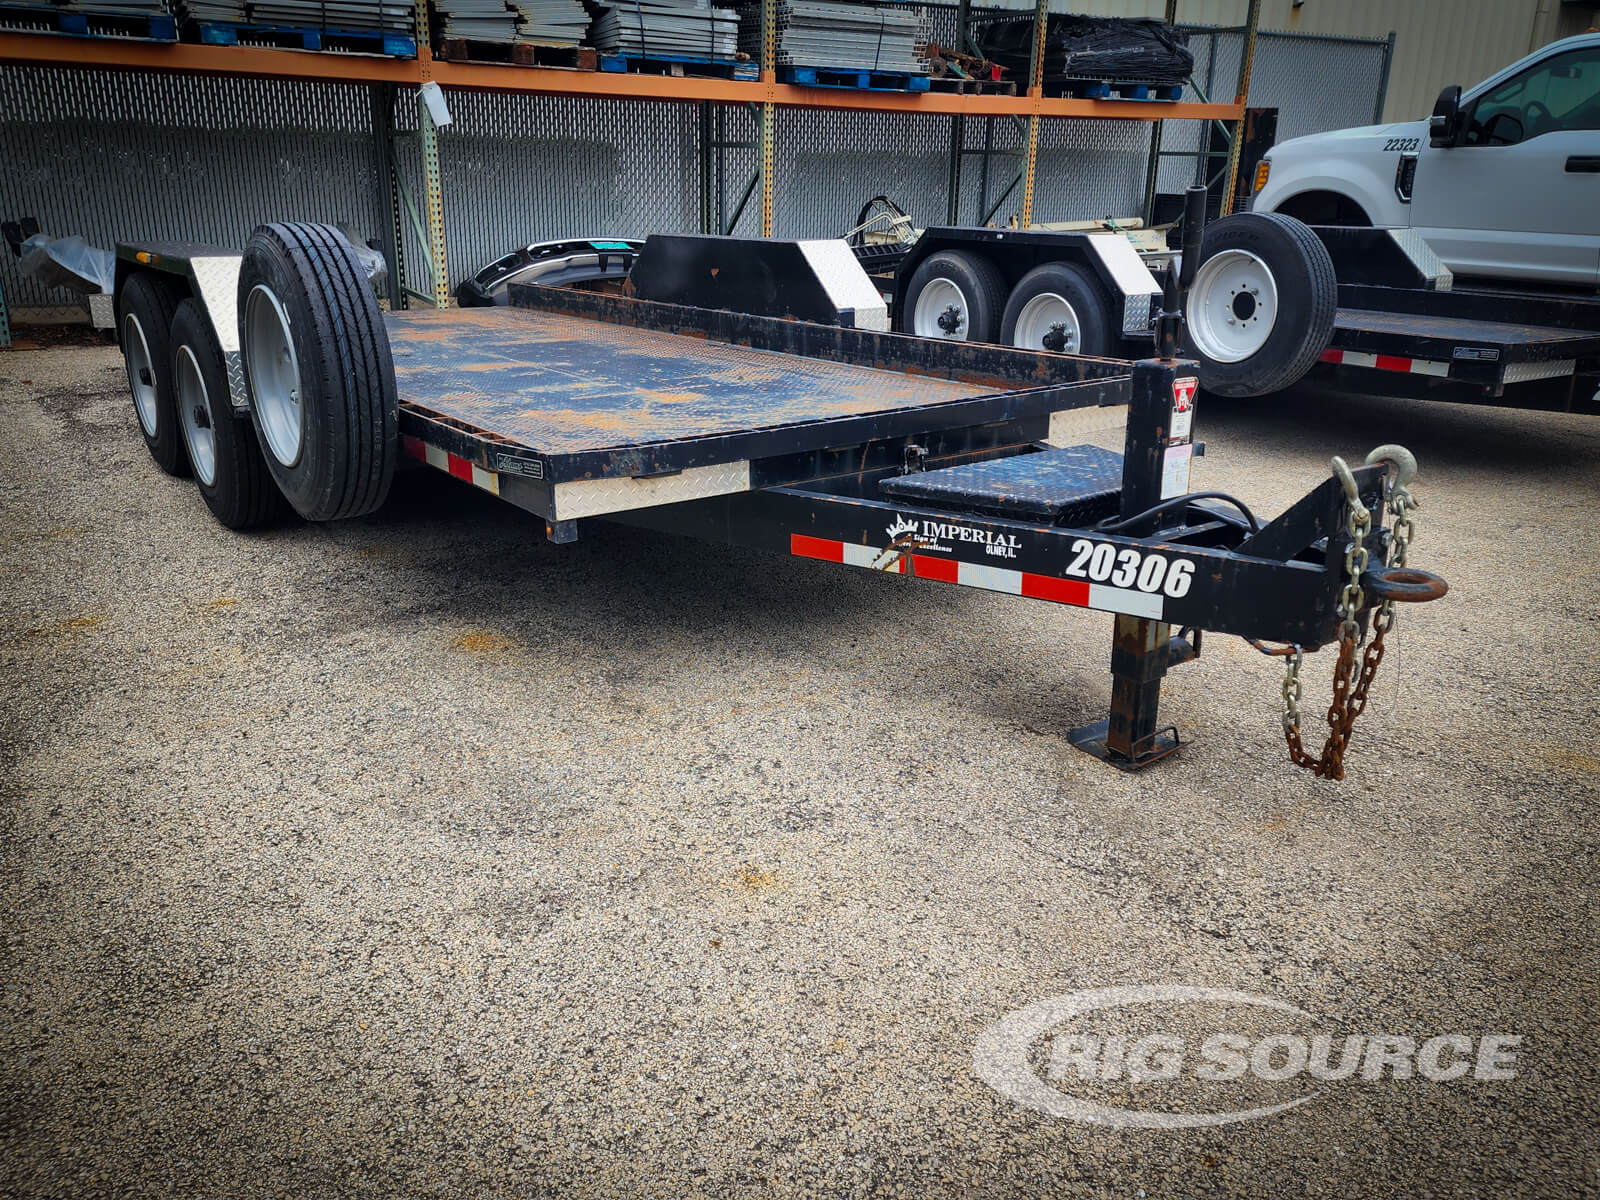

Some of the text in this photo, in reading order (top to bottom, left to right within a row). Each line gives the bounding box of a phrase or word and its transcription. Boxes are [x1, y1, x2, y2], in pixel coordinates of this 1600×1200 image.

[1384, 138, 1419, 151] 22323
[923, 520, 1022, 548] IMPERIAL
[1065, 539, 1196, 598] 20306
